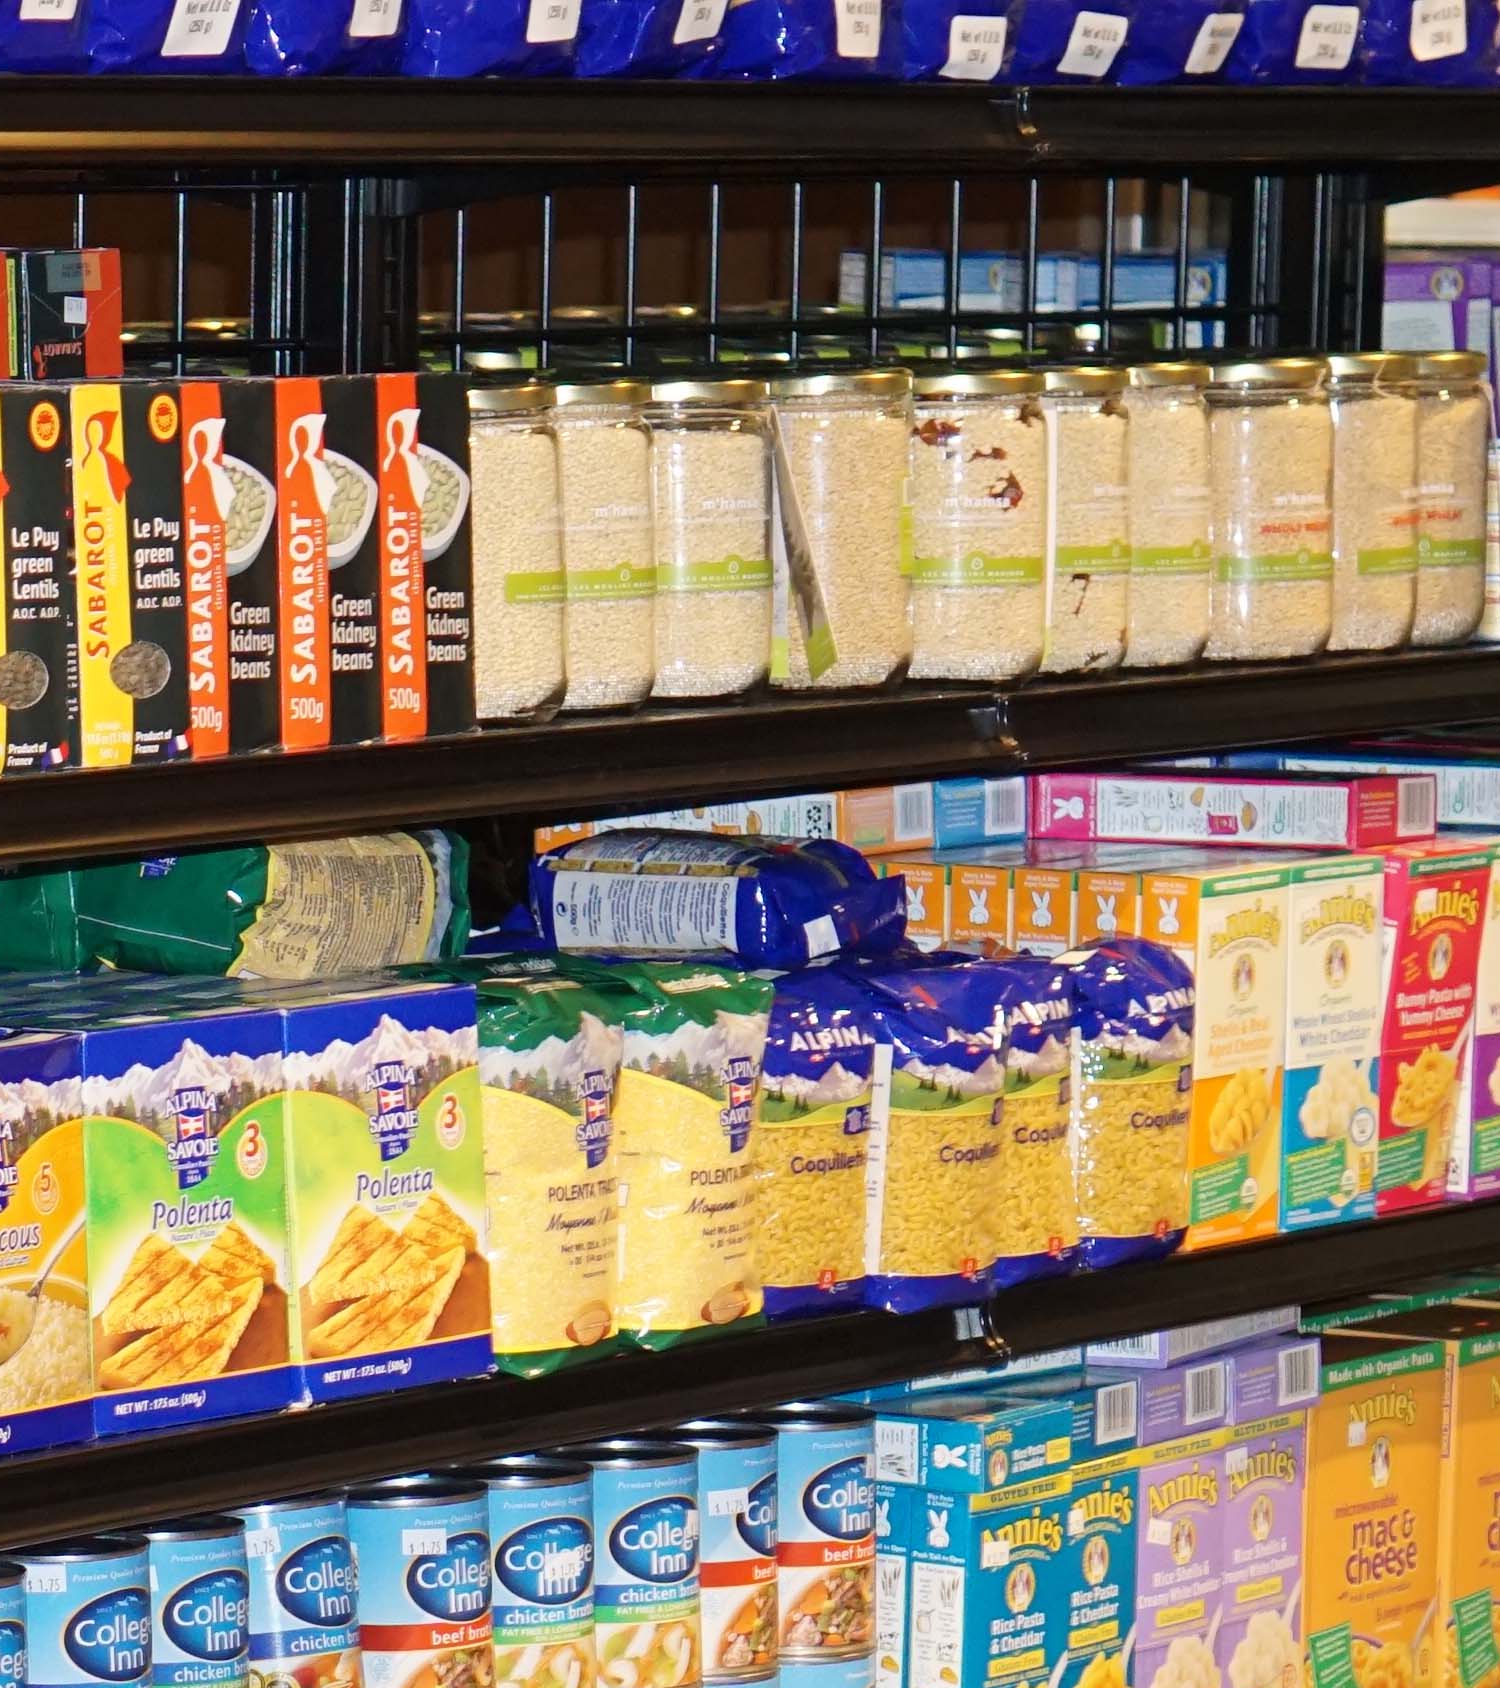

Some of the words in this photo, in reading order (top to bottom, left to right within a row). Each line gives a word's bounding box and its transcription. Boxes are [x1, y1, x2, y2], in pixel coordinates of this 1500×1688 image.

[11, 529, 28, 549] Le
[31, 528, 59, 554] Puy
[12, 556, 54, 582] green
[12, 577, 59, 600] Lentils
[290, 512, 316, 685] SABAROT
[389, 506, 415, 676] SABAROT
[426, 586, 464, 610] Green
[332, 594, 372, 618] Green
[332, 620, 376, 650] kidney
[426, 612, 469, 641] kidney
[332, 646, 374, 671] beans
[428, 638, 467, 662] beans
[291, 697, 324, 723] 500g
[389, 687, 421, 712] 500g
[245, 1121, 258, 1158] 3
[355, 1167, 434, 1200] Polenta
[548, 1184, 594, 1203] POLENTA
[151, 1197, 234, 1231] Polenta
[1329, 1368, 1353, 1384] Made
[1355, 1363, 1375, 1379] with
[1377, 1356, 1410, 1376] Organic
[1412, 1352, 1434, 1368] Pasta
[1149, 1466, 1217, 1515] Annie's
[1353, 1513, 1397, 1548] mac
[1401, 1509, 1414, 1536] &
[1345, 1543, 1417, 1584] cheese
[992, 1616, 1017, 1635] Rice
[1017, 1611, 1046, 1632] Pasta
[431, 1628, 461, 1645] beef
